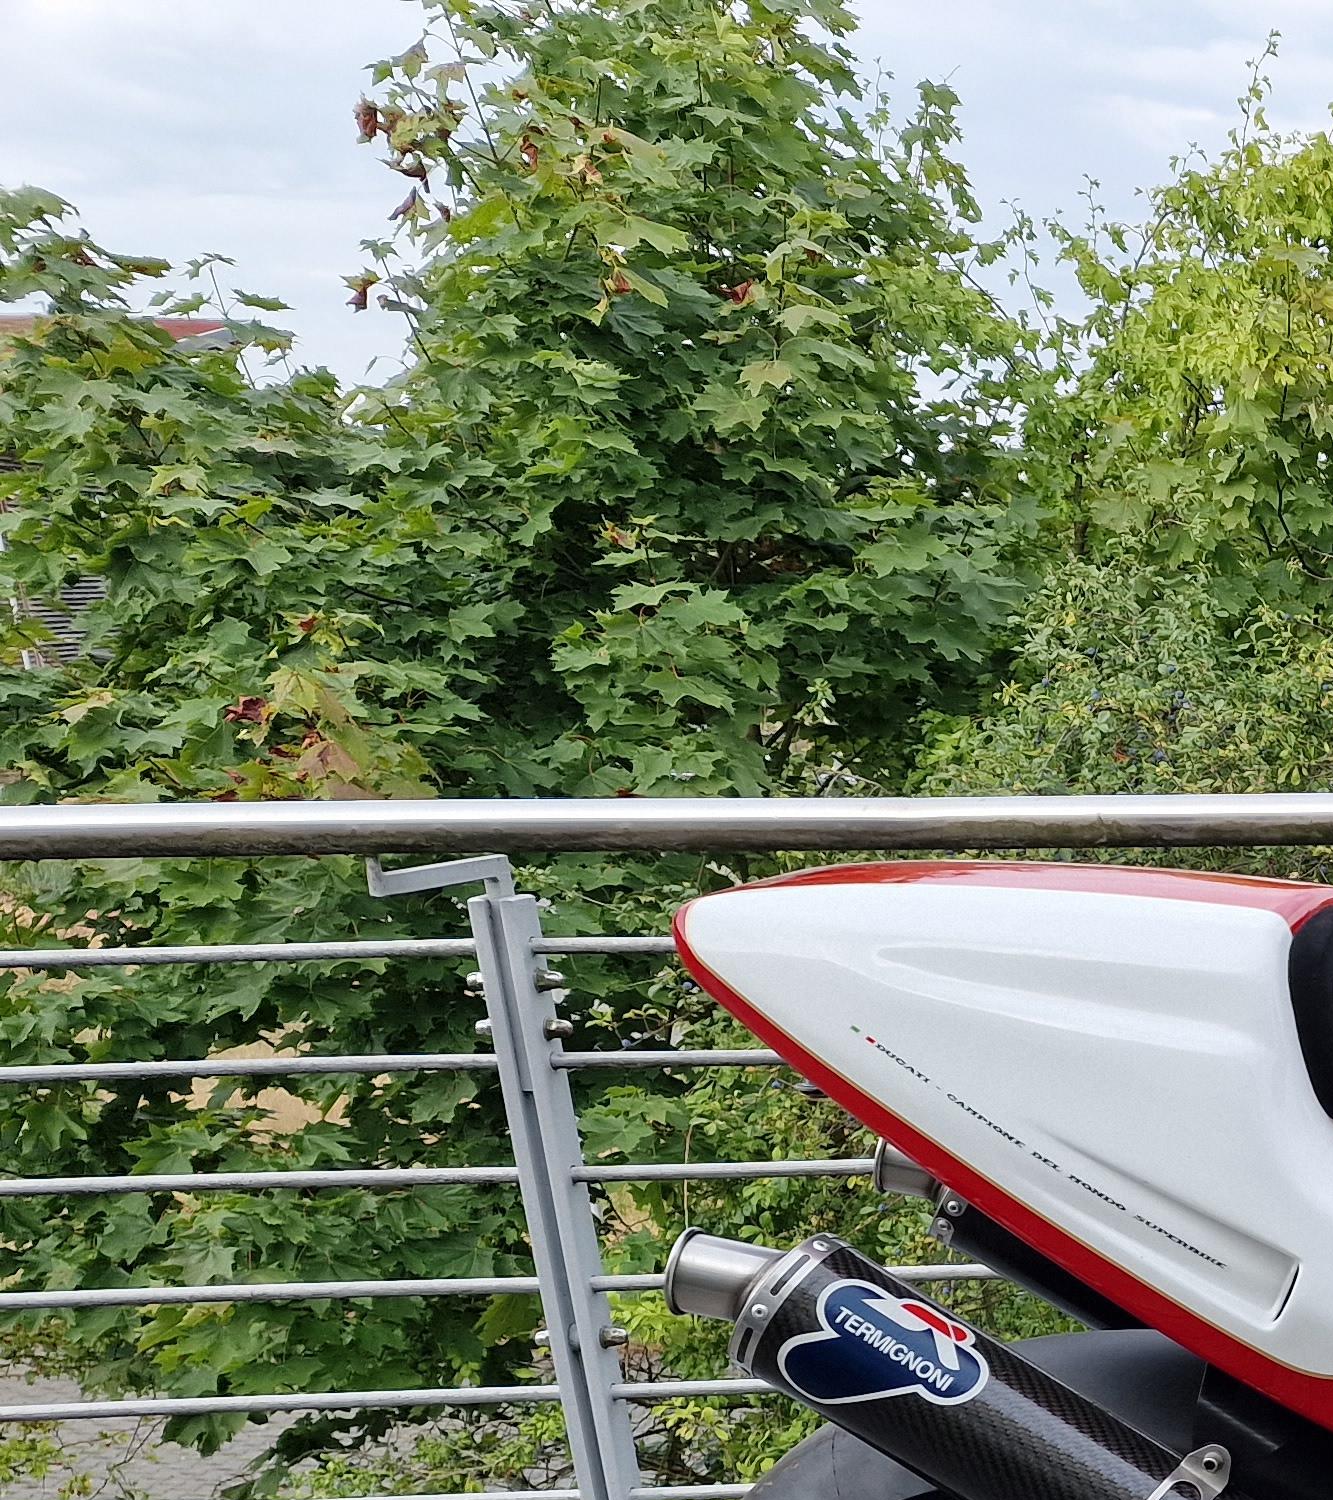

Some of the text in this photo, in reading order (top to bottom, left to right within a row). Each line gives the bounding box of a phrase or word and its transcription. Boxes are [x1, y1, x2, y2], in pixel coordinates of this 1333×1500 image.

[875, 1043, 931, 1084] DUCATI
[947, 1093, 1027, 1149] CAMPIONE
[1031, 1151, 1062, 1173] DEL
[1067, 1174, 1127, 1212] MONDO
[834, 1305, 956, 1392] TERMIGNONI
